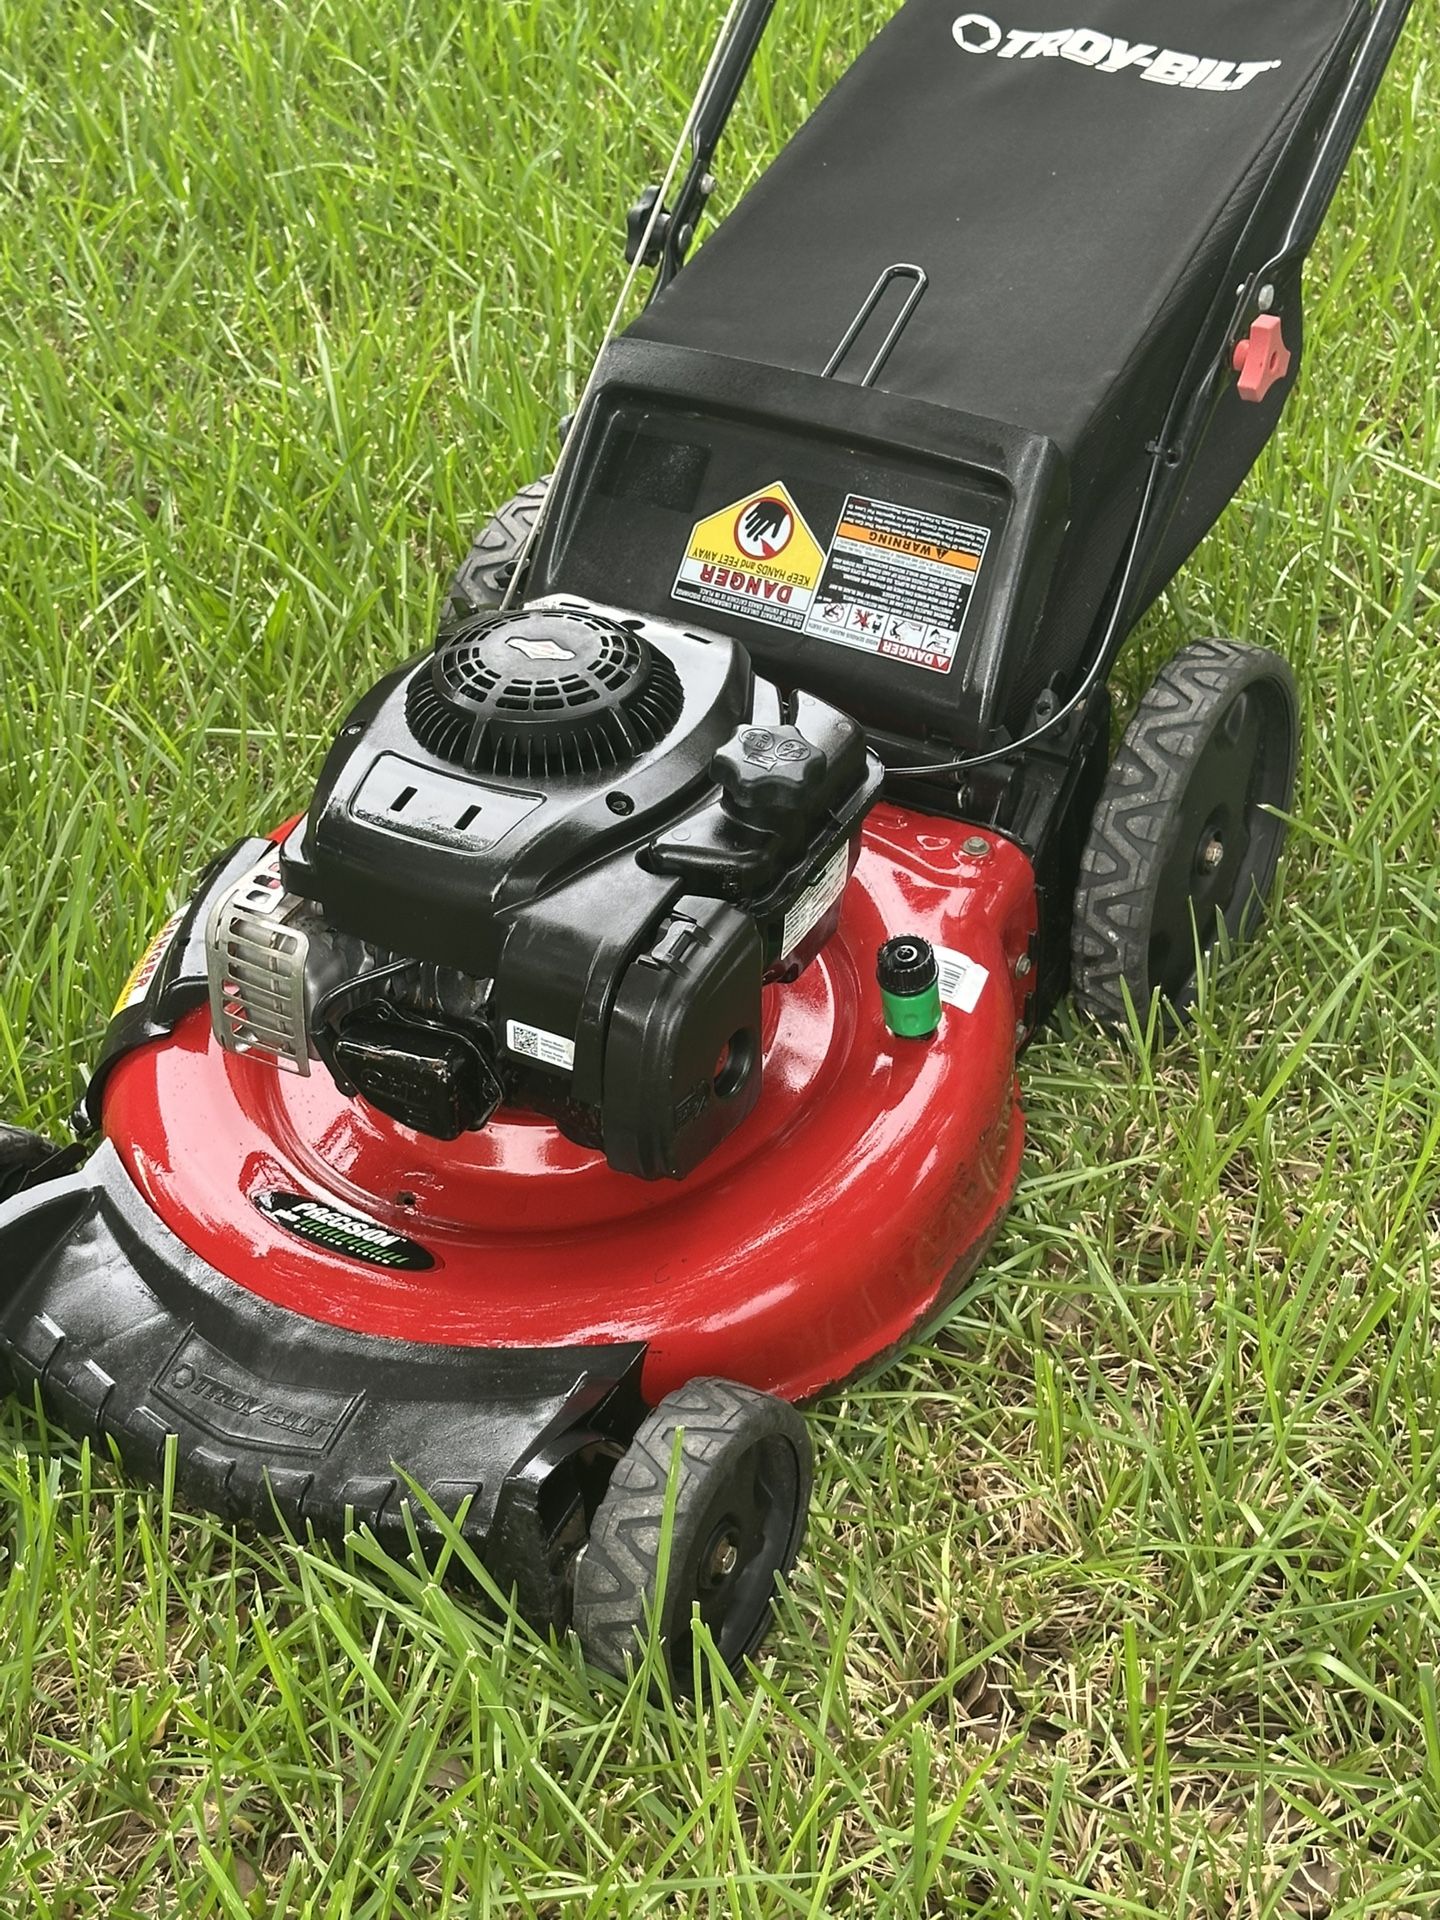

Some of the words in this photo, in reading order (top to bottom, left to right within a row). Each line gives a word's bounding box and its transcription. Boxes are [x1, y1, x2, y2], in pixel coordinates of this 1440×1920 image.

[997, 28, 1276, 91] TROY-BILT
[693, 547, 718, 561] AWAY
[869, 532, 931, 554] WARNING
[718, 554, 739, 566] FEET
[740, 560, 755, 571] and
[756, 564, 786, 579] HANDS
[787, 572, 810, 585] KEEP
[699, 564, 793, 603] DANGER
[883, 641, 934, 663] DANGER
[133, 915, 183, 990] DANGER
[291, 1202, 402, 1248] PRECISION
[191, 1373, 332, 1438] TROY-BILT
